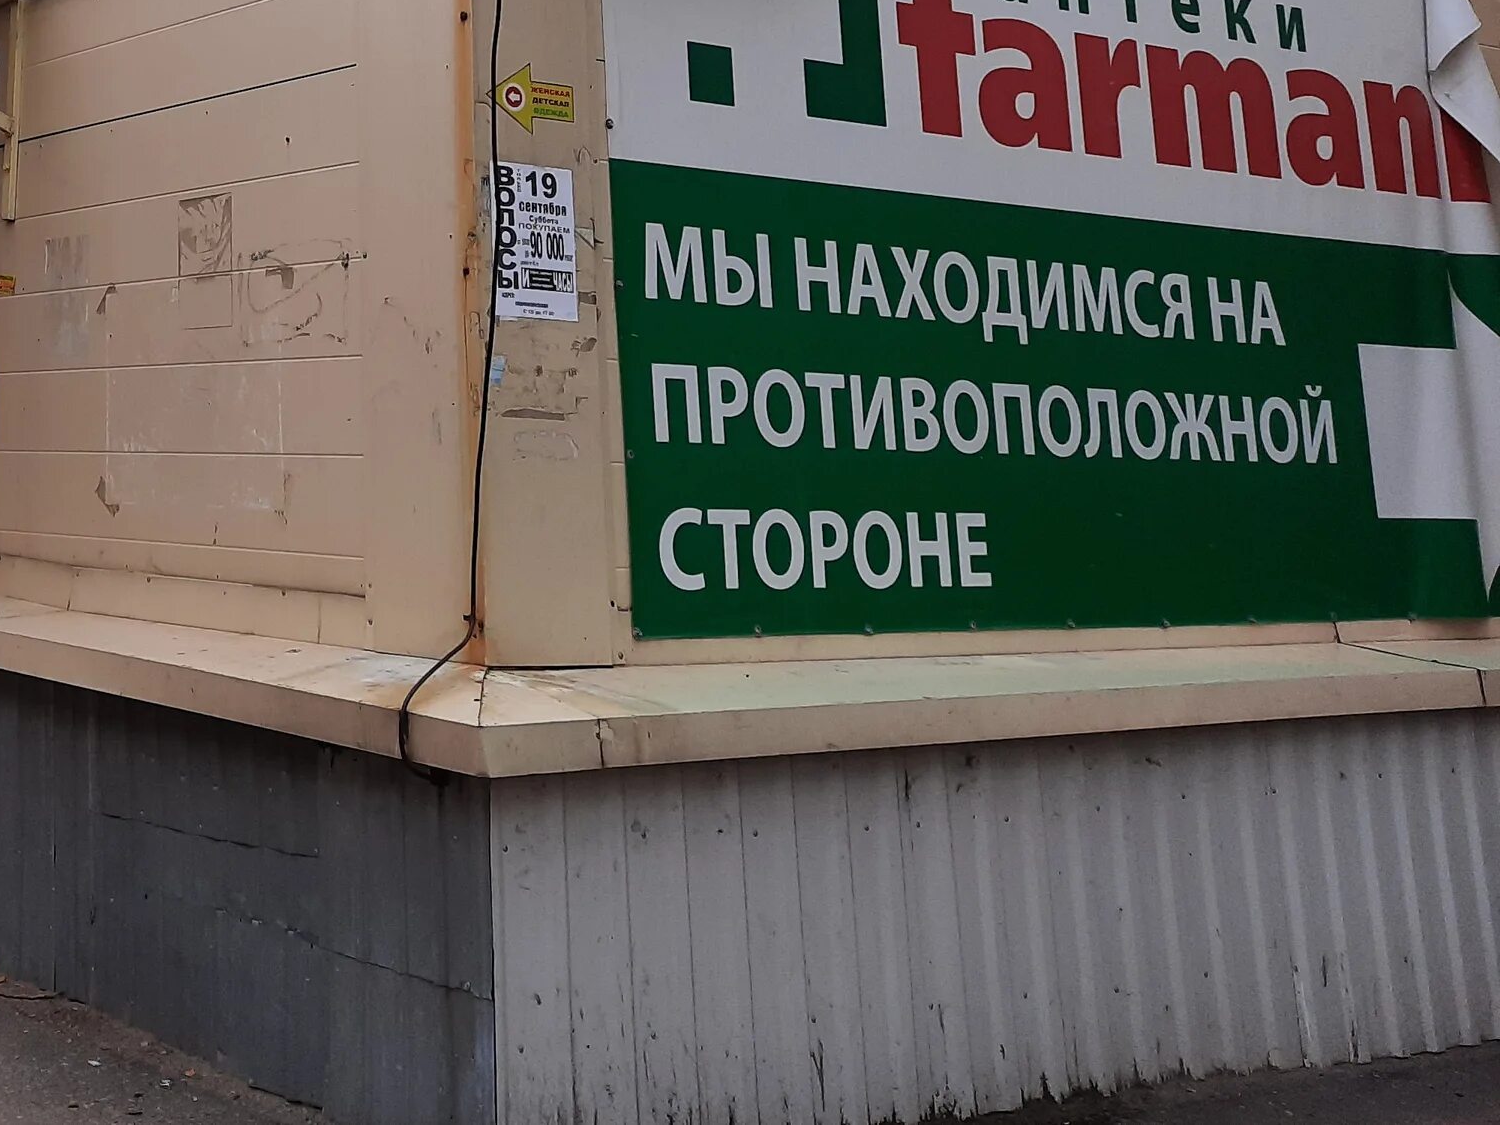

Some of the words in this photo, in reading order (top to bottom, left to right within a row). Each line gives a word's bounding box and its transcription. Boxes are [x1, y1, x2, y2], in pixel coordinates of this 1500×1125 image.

[530, 86, 570, 97] ЖЕНСКАЯ
[532, 97, 570, 108] ДЕТСКАЯ
[525, 170, 558, 198] 19
[518, 201, 567, 217] сентября
[518, 222, 571, 234] ПОКУПАЕМ
[529, 215, 559, 225] Суббота
[552, 272, 574, 292] ЧАСЫ
[644, 221, 773, 310] МЫ
[795, 236, 1195, 347] НАХОДИМСЯ
[1208, 277, 1286, 347] НА
[650, 362, 1338, 466] ПРОТИВОПОЛОЖНОЙ
[658, 506, 994, 592] СТОРОНЕ
